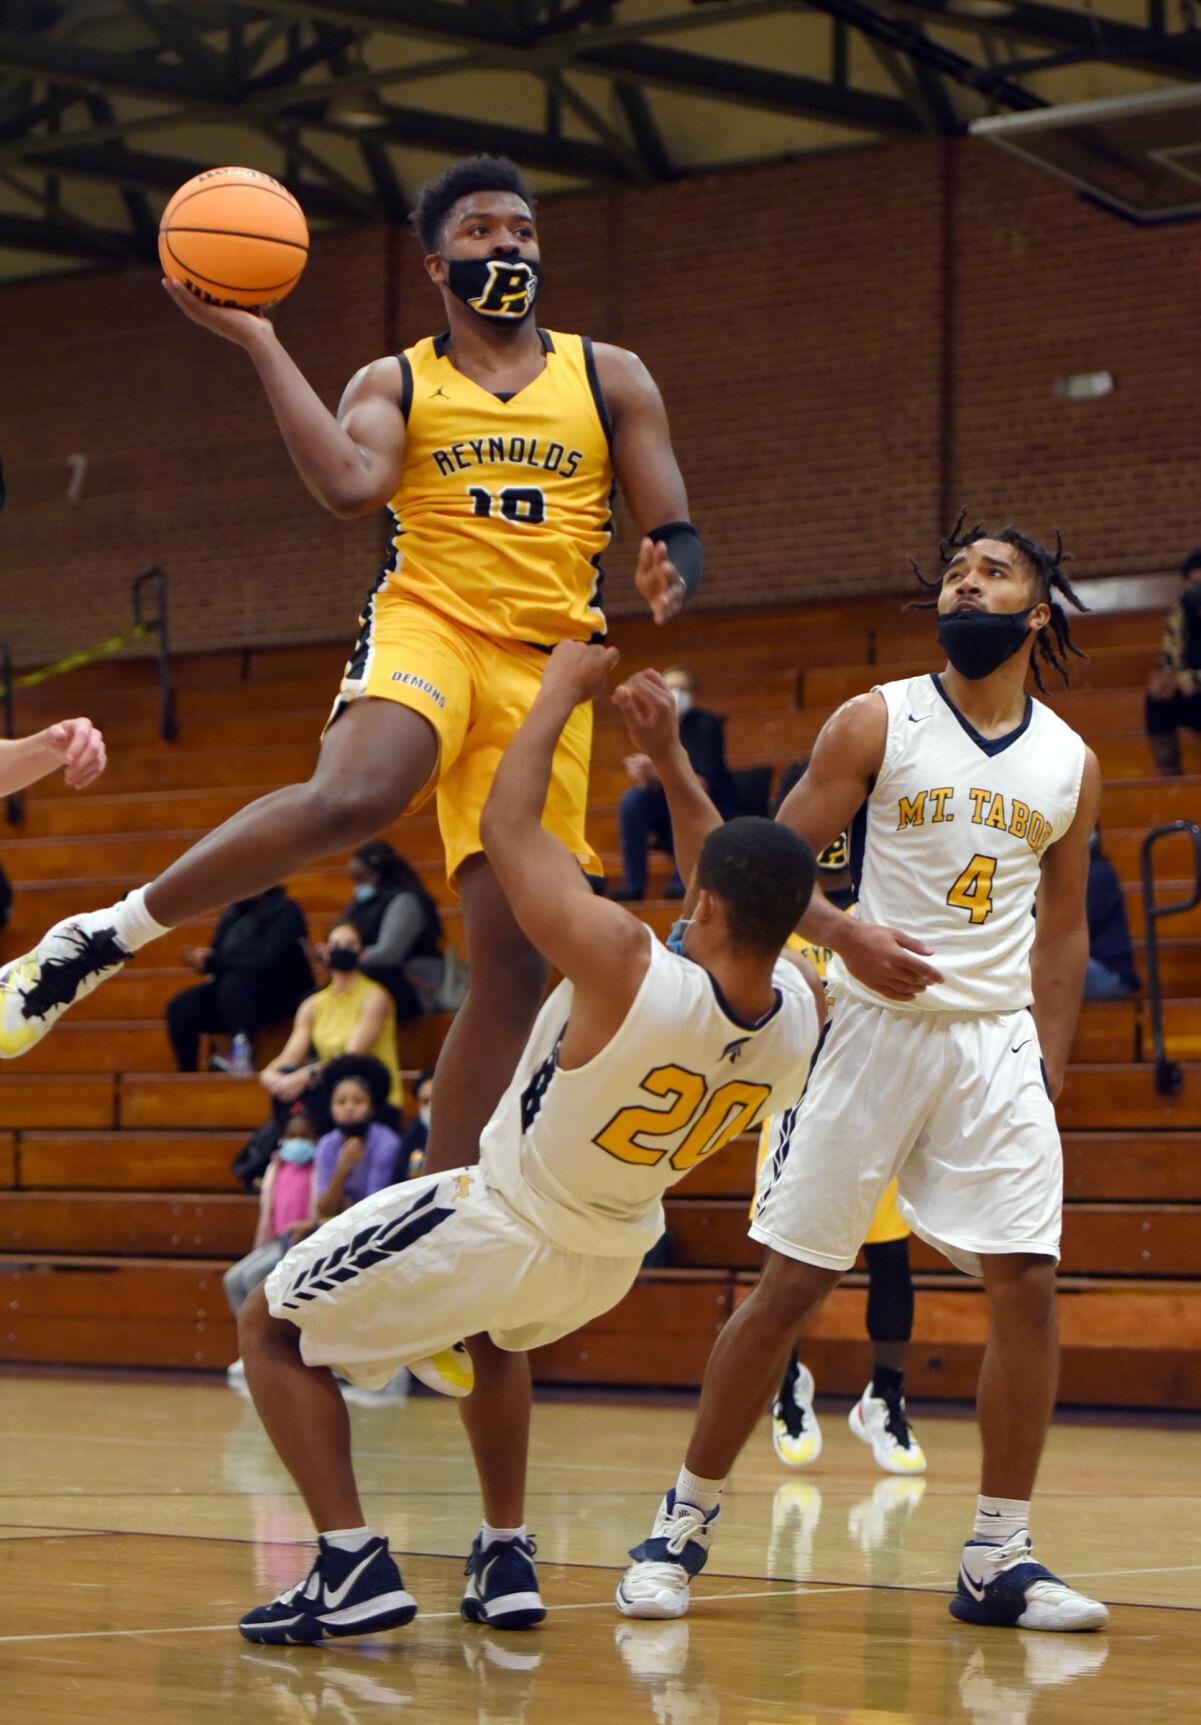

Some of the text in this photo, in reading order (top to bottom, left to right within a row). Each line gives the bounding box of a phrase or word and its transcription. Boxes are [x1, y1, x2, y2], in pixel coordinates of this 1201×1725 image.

[431, 436, 584, 479] REYNOLDS
[391, 671, 447, 709] DEMONS
[896, 786, 954, 831] MT.
[946, 853, 998, 925] 4
[590, 1063, 773, 1171] 20
